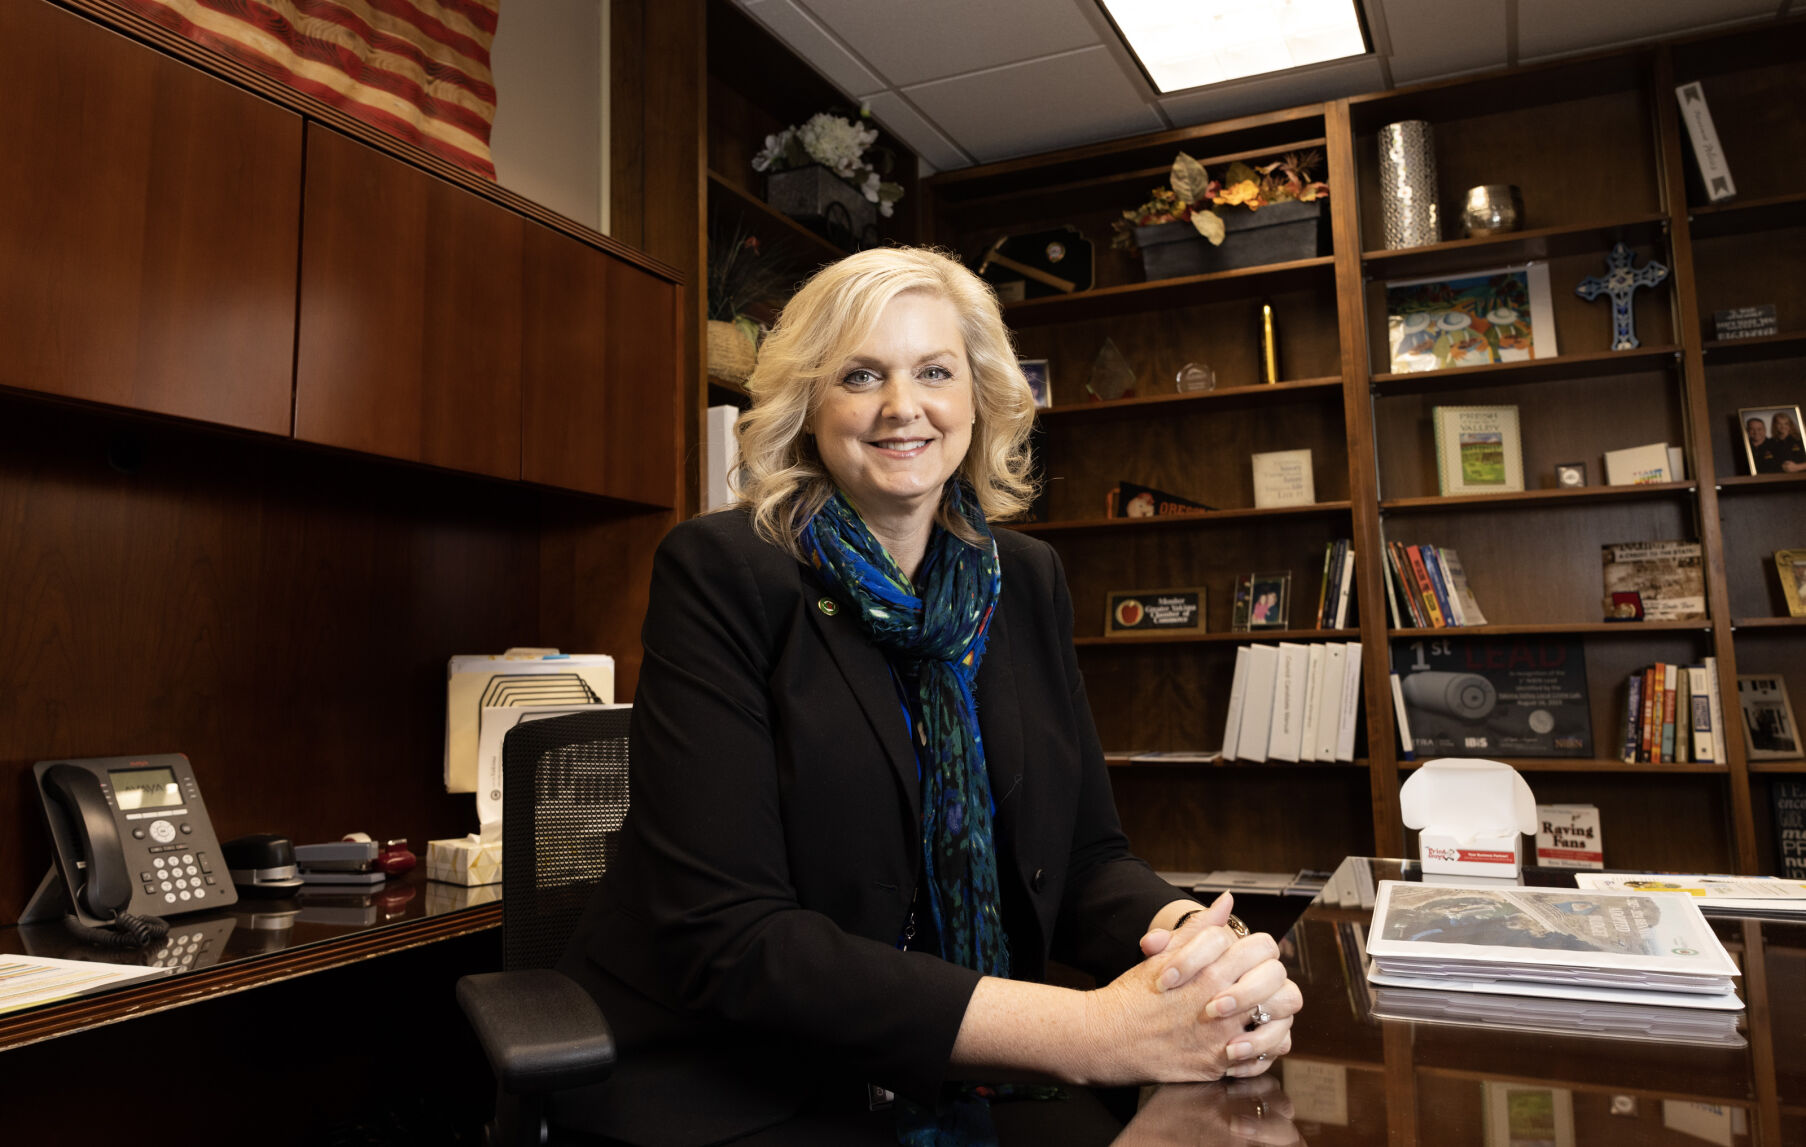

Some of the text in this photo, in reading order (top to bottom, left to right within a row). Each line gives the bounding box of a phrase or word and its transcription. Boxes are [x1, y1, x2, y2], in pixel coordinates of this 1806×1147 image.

[1410, 639, 1568, 671] 1st LEAD
[1542, 821, 1594, 840] Raving
[1553, 835, 1586, 848] Fans
